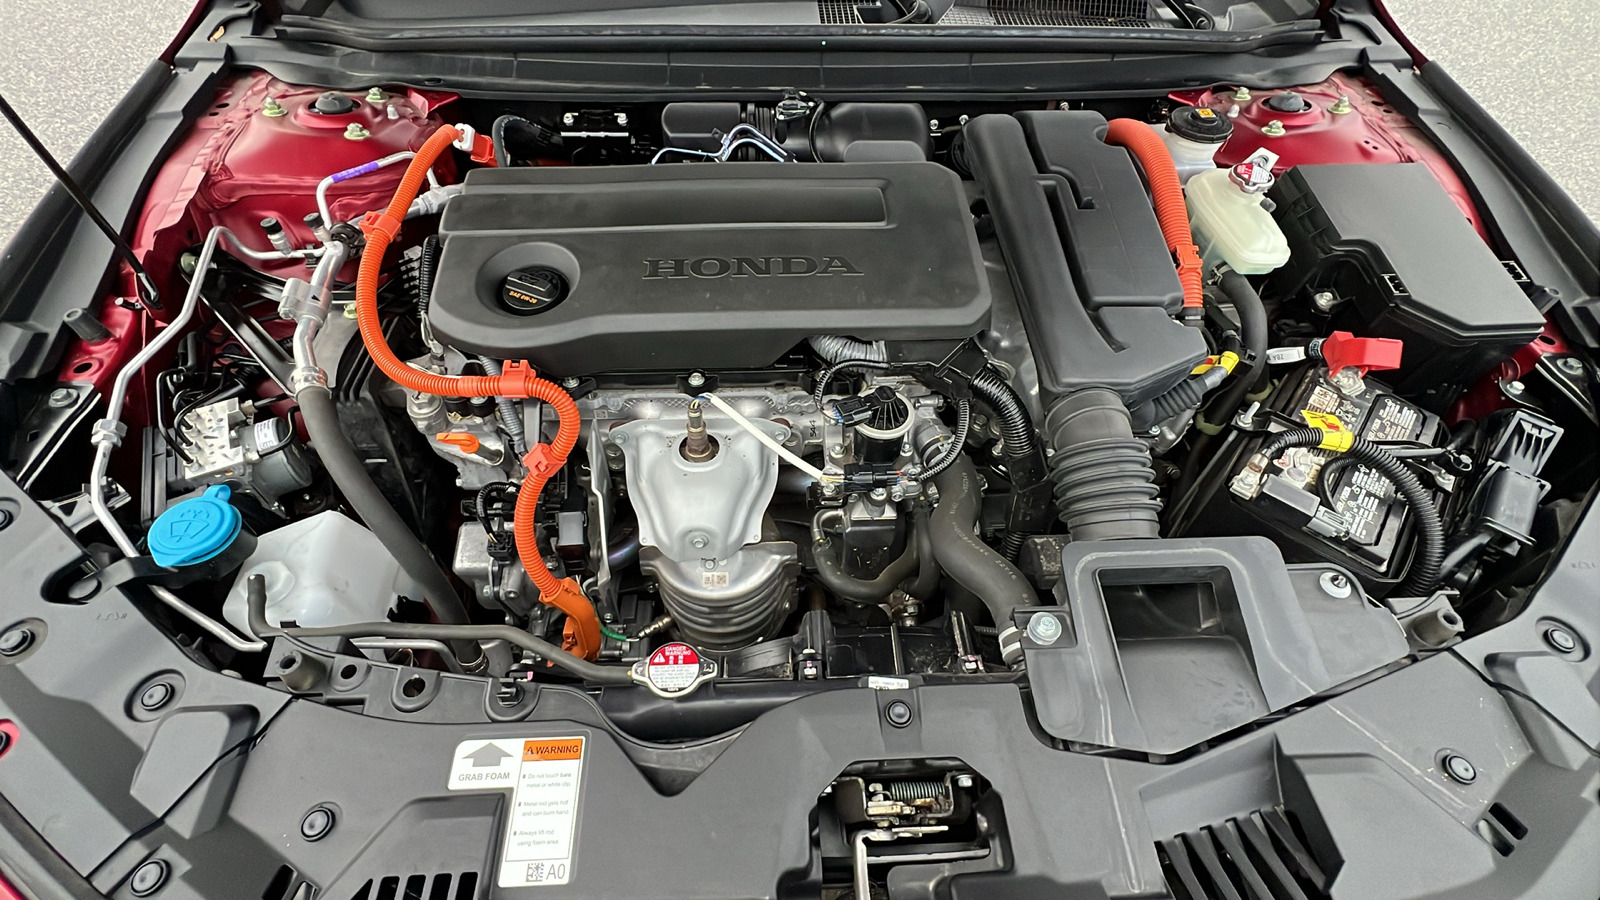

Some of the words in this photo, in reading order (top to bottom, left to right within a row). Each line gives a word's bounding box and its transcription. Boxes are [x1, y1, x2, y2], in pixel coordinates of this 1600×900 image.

[642, 256, 865, 279] HONDA
[535, 745, 579, 755] WARNING
[458, 773, 483, 781] GRAB
[485, 772, 510, 781] FOAM
[546, 864, 566, 880] A0
